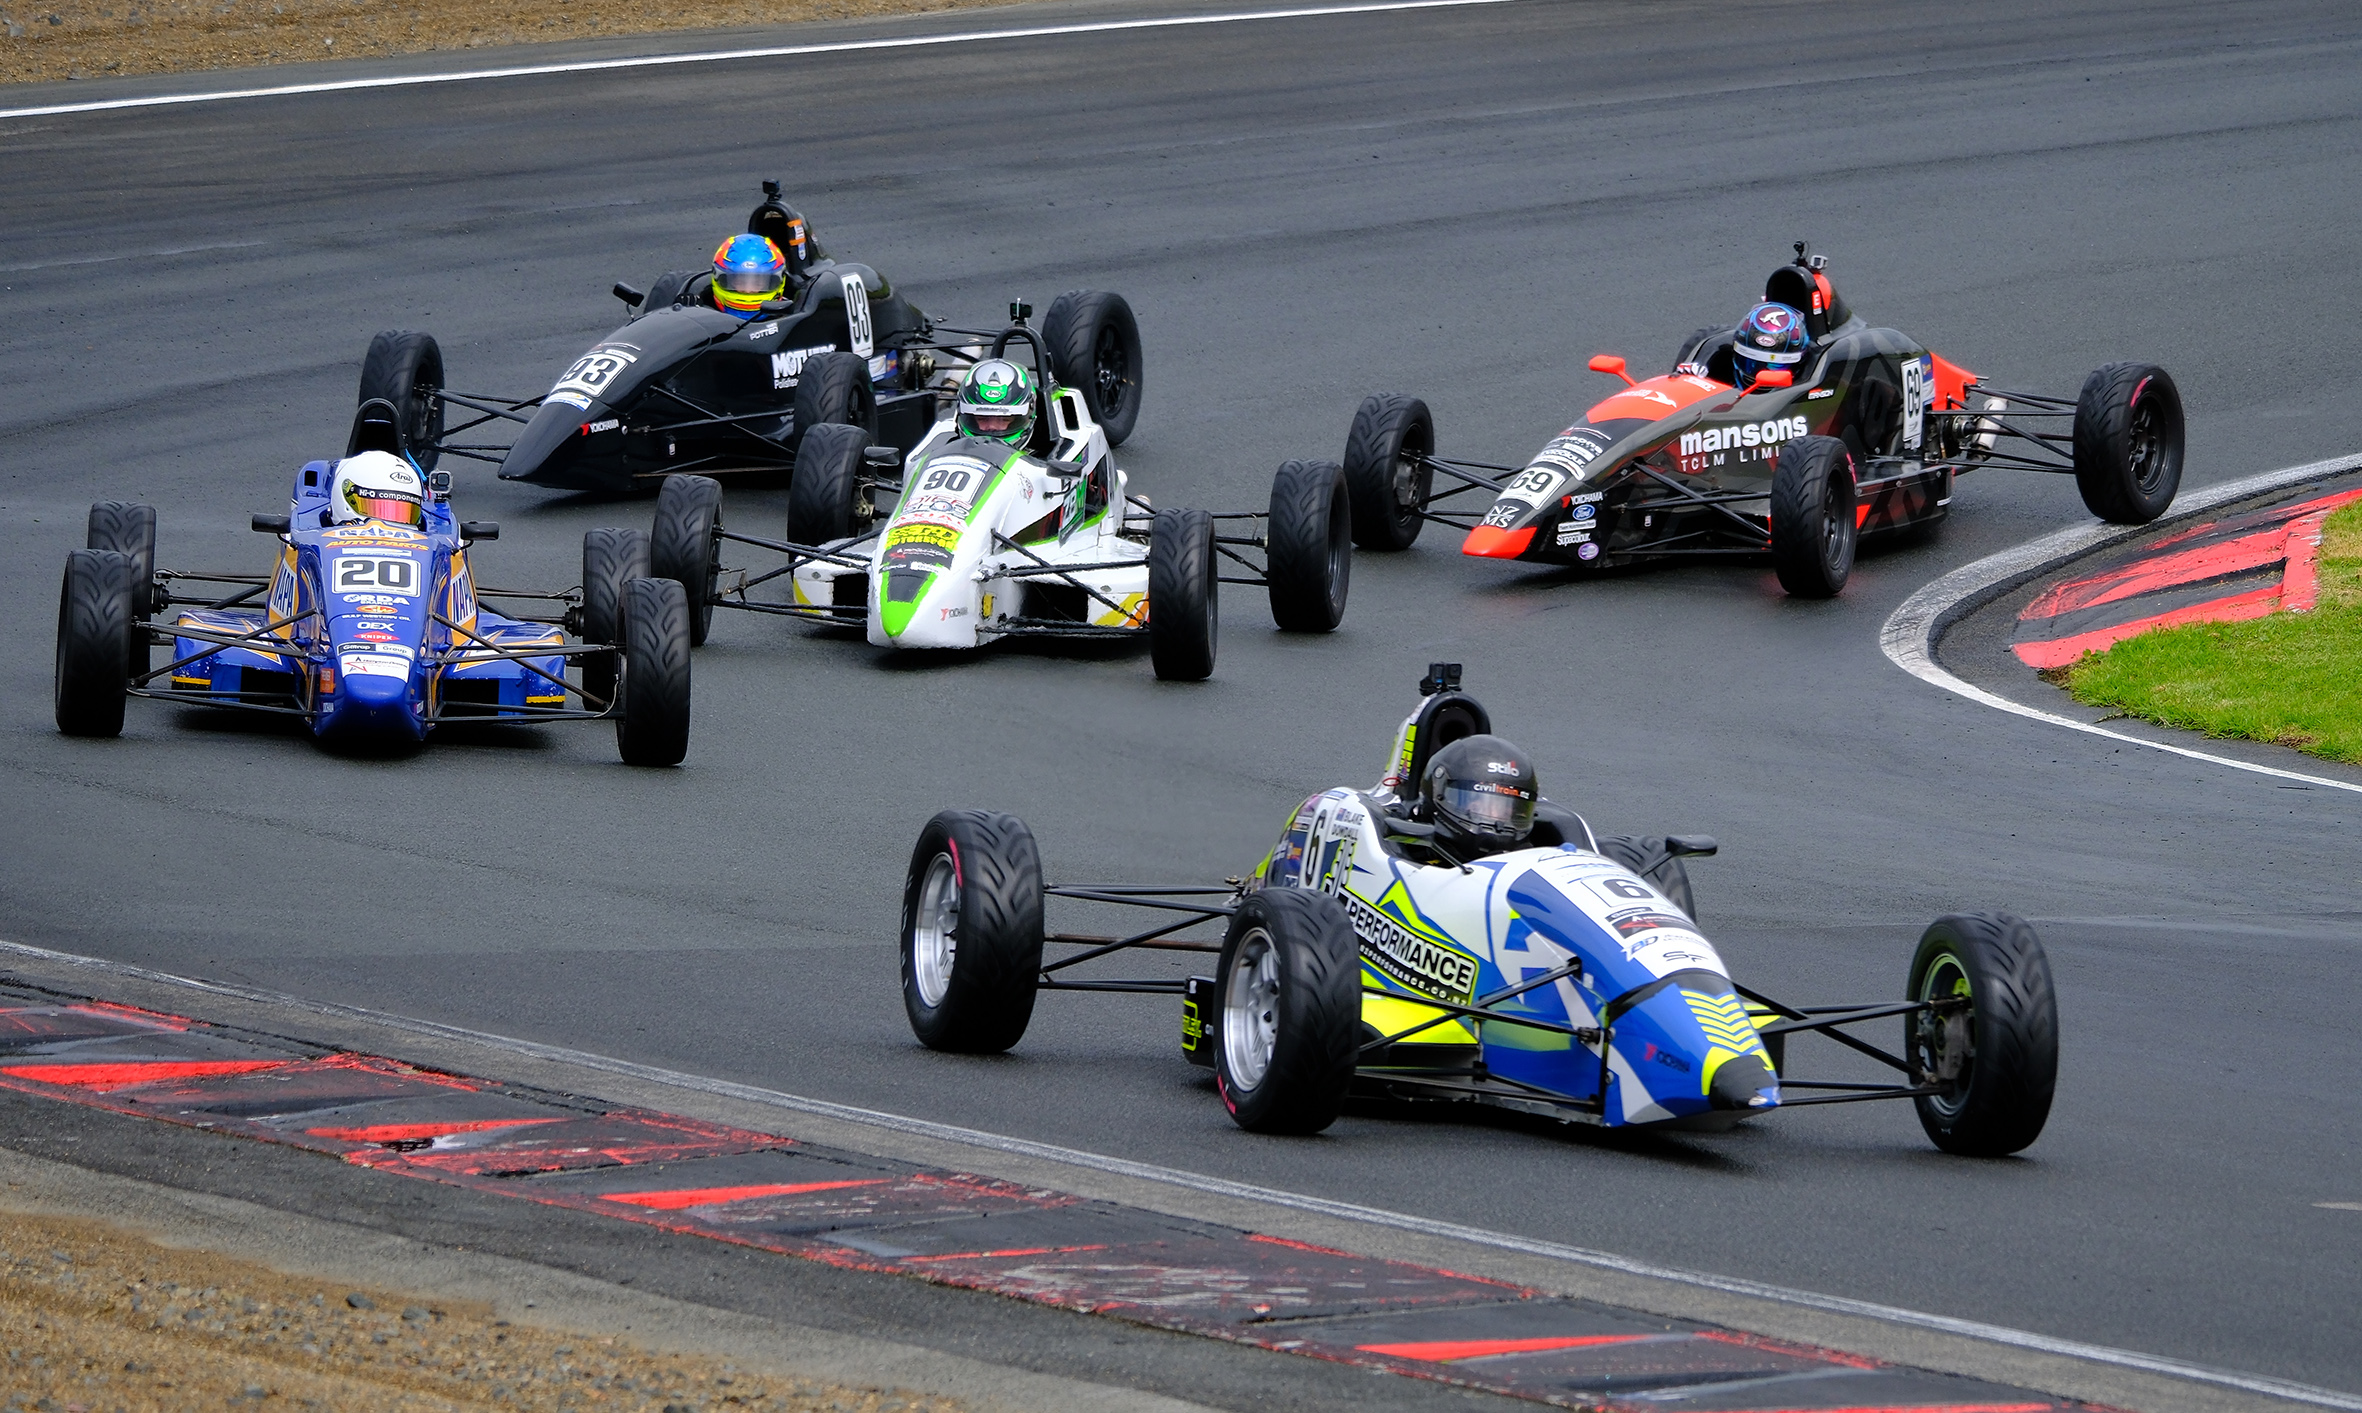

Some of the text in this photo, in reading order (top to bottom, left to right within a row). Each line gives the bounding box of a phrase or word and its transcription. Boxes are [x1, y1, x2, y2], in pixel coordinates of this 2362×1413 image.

[847, 281, 870, 345] 93
[750, 326, 780, 341] POTTER
[560, 357, 619, 386] 93
[1906, 367, 1919, 418] 69
[1680, 414, 1808, 457] mansons
[1681, 453, 1725, 472] TCLM
[395, 472, 411, 482] Arai
[923, 469, 971, 492] 90
[1508, 469, 1554, 494] 69
[1571, 491, 1604, 506] YOKOHAMA
[339, 527, 411, 539] NAPA
[326, 540, 430, 551] AUTO PARTS
[341, 559, 412, 588] 20
[272, 567, 296, 618] NAPA
[360, 593, 411, 606] RDA
[452, 571, 476, 624] NAPA
[357, 621, 395, 632] OEX
[382, 646, 408, 654] Group
[1486, 760, 1520, 778] Stilo
[1305, 808, 1327, 887] 6
[1602, 878, 1655, 899] 6
[1349, 900, 1473, 992] PERFORMANCE
